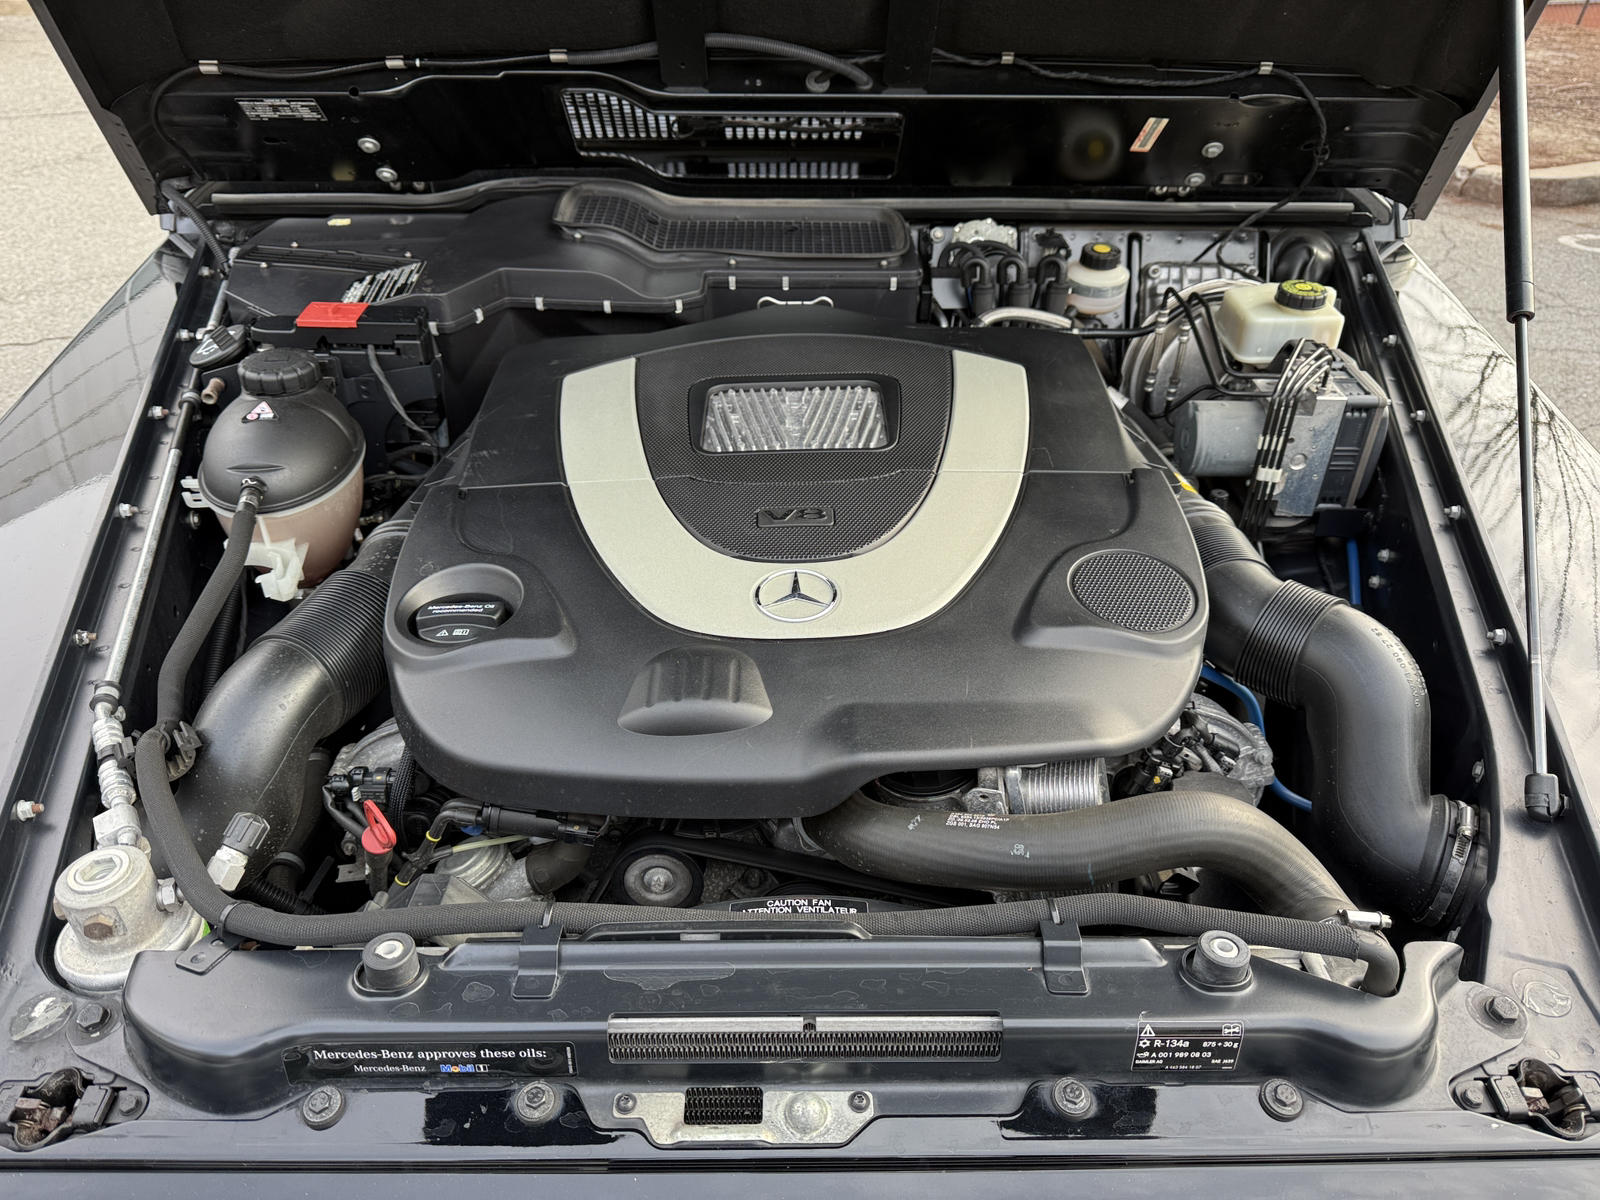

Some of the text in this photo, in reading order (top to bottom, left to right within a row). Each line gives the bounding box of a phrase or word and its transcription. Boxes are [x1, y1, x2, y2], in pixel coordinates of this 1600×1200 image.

[763, 509, 828, 521] V8
[766, 899, 808, 907] CAUTION
[796, 906, 858, 914] VENTILATEUR
[1154, 1040, 1190, 1048] R-134a
[313, 1048, 547, 1060] Mercedes-Benz approves these oils:
[353, 1064, 427, 1073] Mercedes-Benz
[440, 1064, 475, 1072] Mobil
